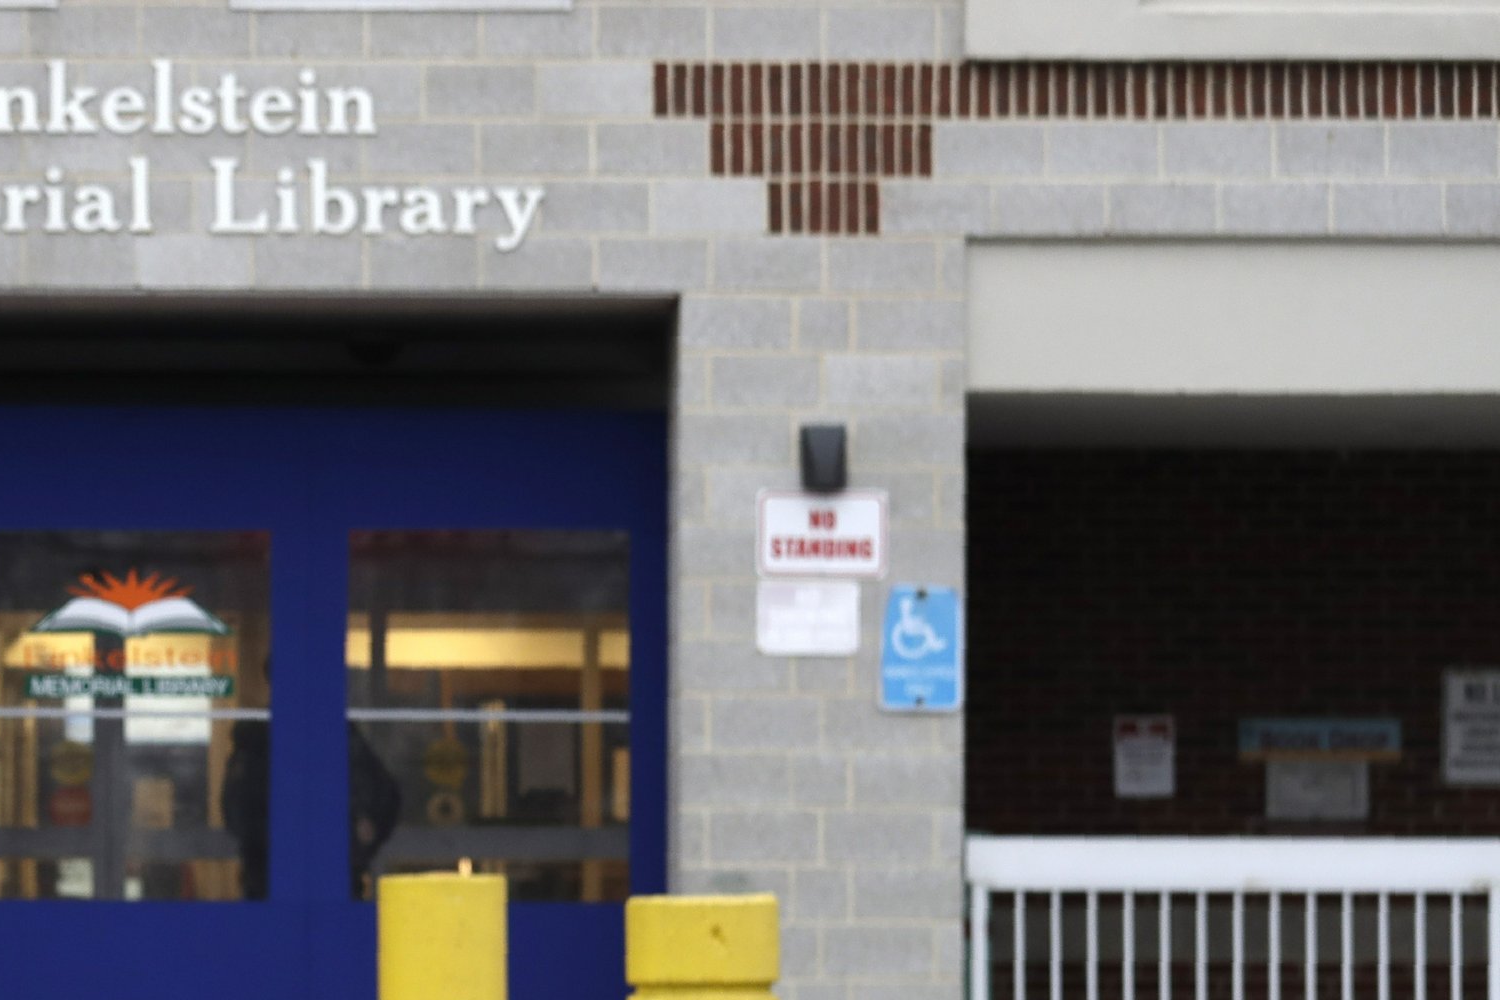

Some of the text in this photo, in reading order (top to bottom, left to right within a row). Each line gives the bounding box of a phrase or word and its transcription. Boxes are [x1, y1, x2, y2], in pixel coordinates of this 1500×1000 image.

[209, 157, 543, 250] Library
[809, 509, 837, 530] NO
[772, 536, 873, 559] STANDING
[30, 676, 229, 696] MEMORIAL LIBRARY
